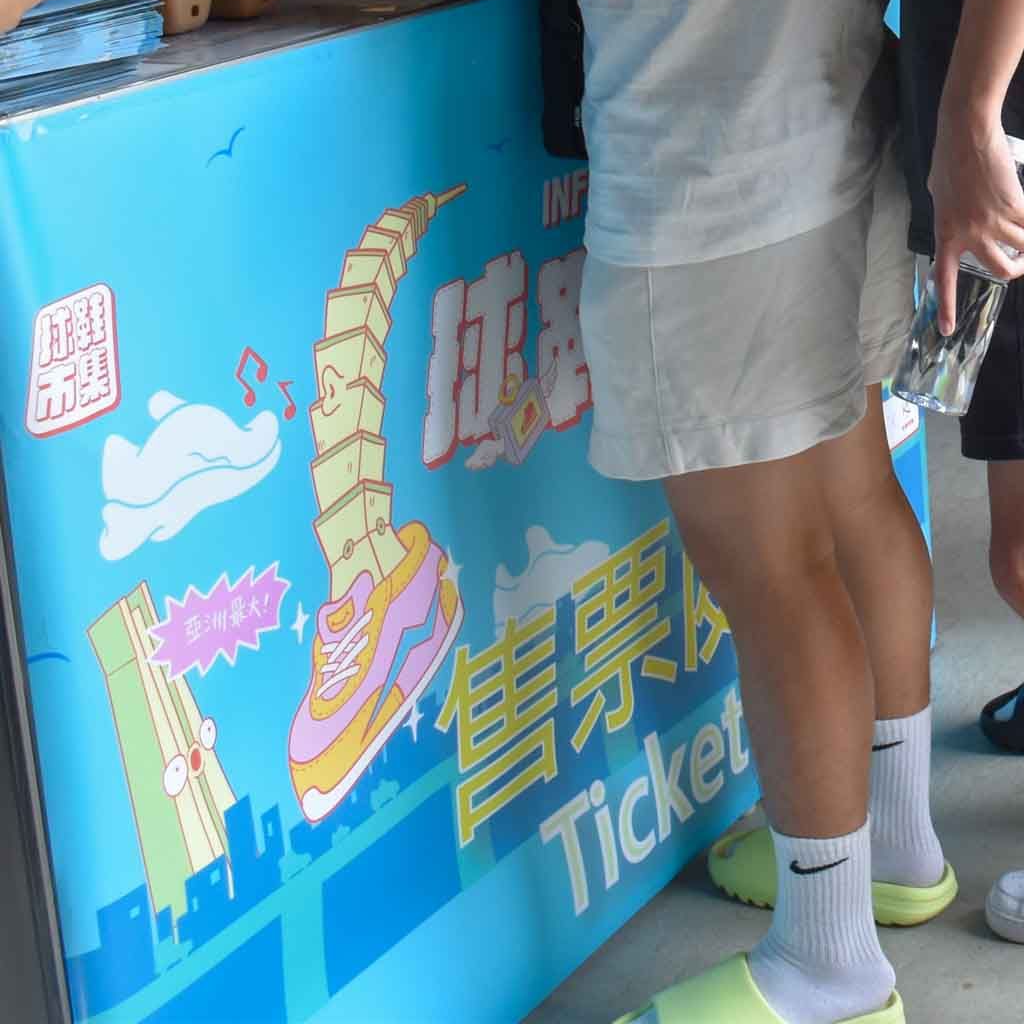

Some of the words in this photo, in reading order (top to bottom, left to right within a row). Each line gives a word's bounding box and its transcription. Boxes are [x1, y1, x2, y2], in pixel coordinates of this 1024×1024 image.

[542, 172, 589, 228] INF
[38, 291, 107, 368] 球鞋
[34, 346, 112, 422] 市集
[538, 685, 751, 918] Ticket
